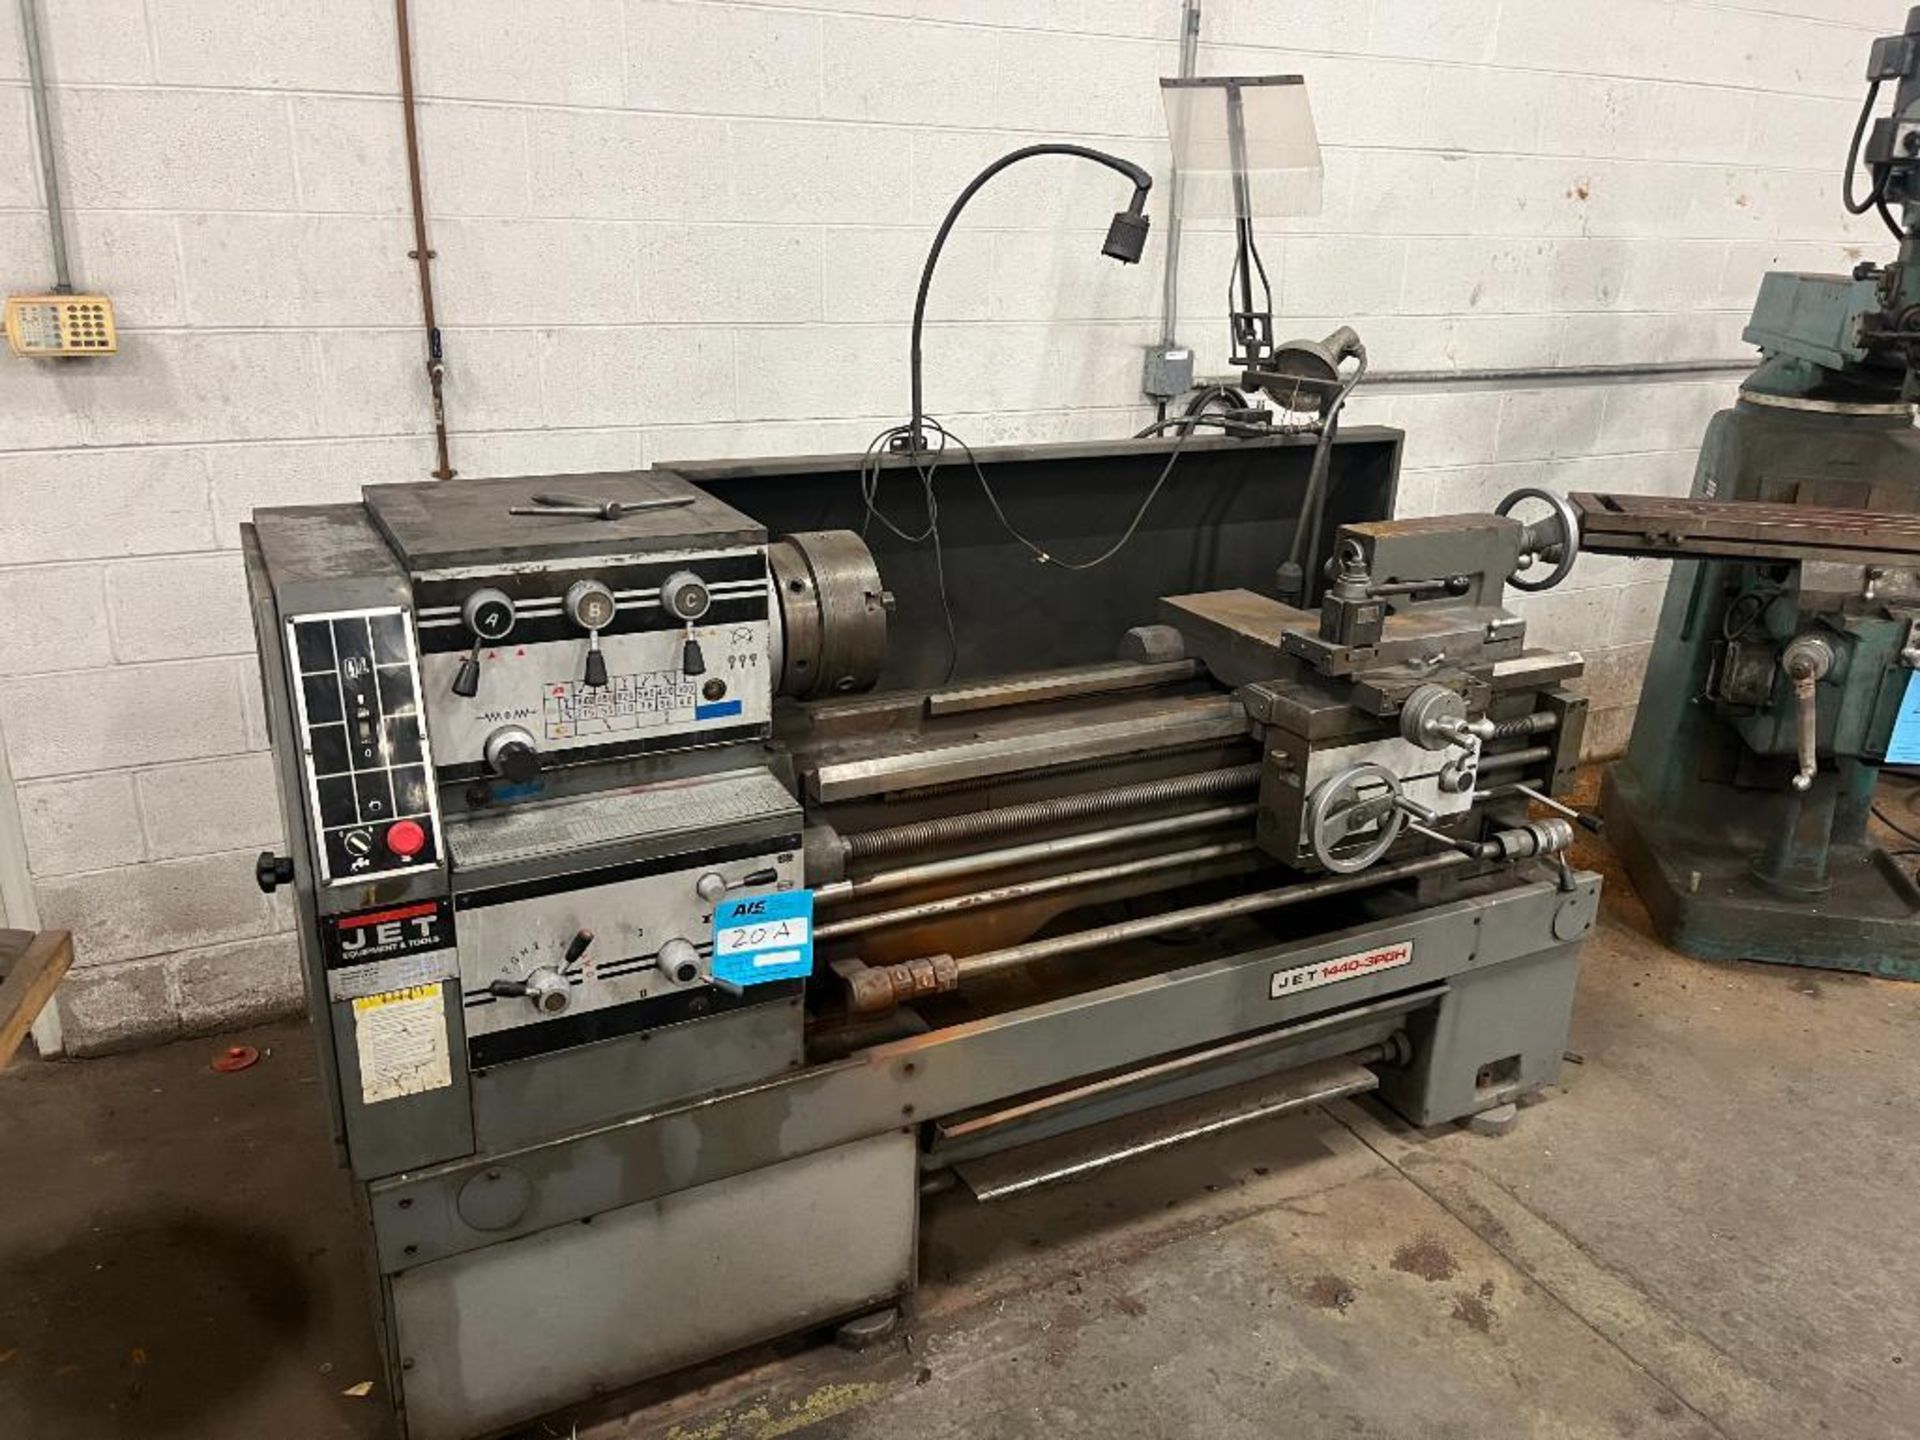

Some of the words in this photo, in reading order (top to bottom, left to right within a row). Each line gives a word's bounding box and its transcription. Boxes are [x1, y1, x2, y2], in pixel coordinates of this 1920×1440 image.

[685, 593, 697, 608] C
[588, 603, 601, 618] B
[485, 613, 499, 628] A
[341, 916, 438, 950] JET
[342, 943, 398, 960] EQUIPMENT
[408, 936, 440, 947] TOOLS
[1278, 971, 1318, 989] JET
